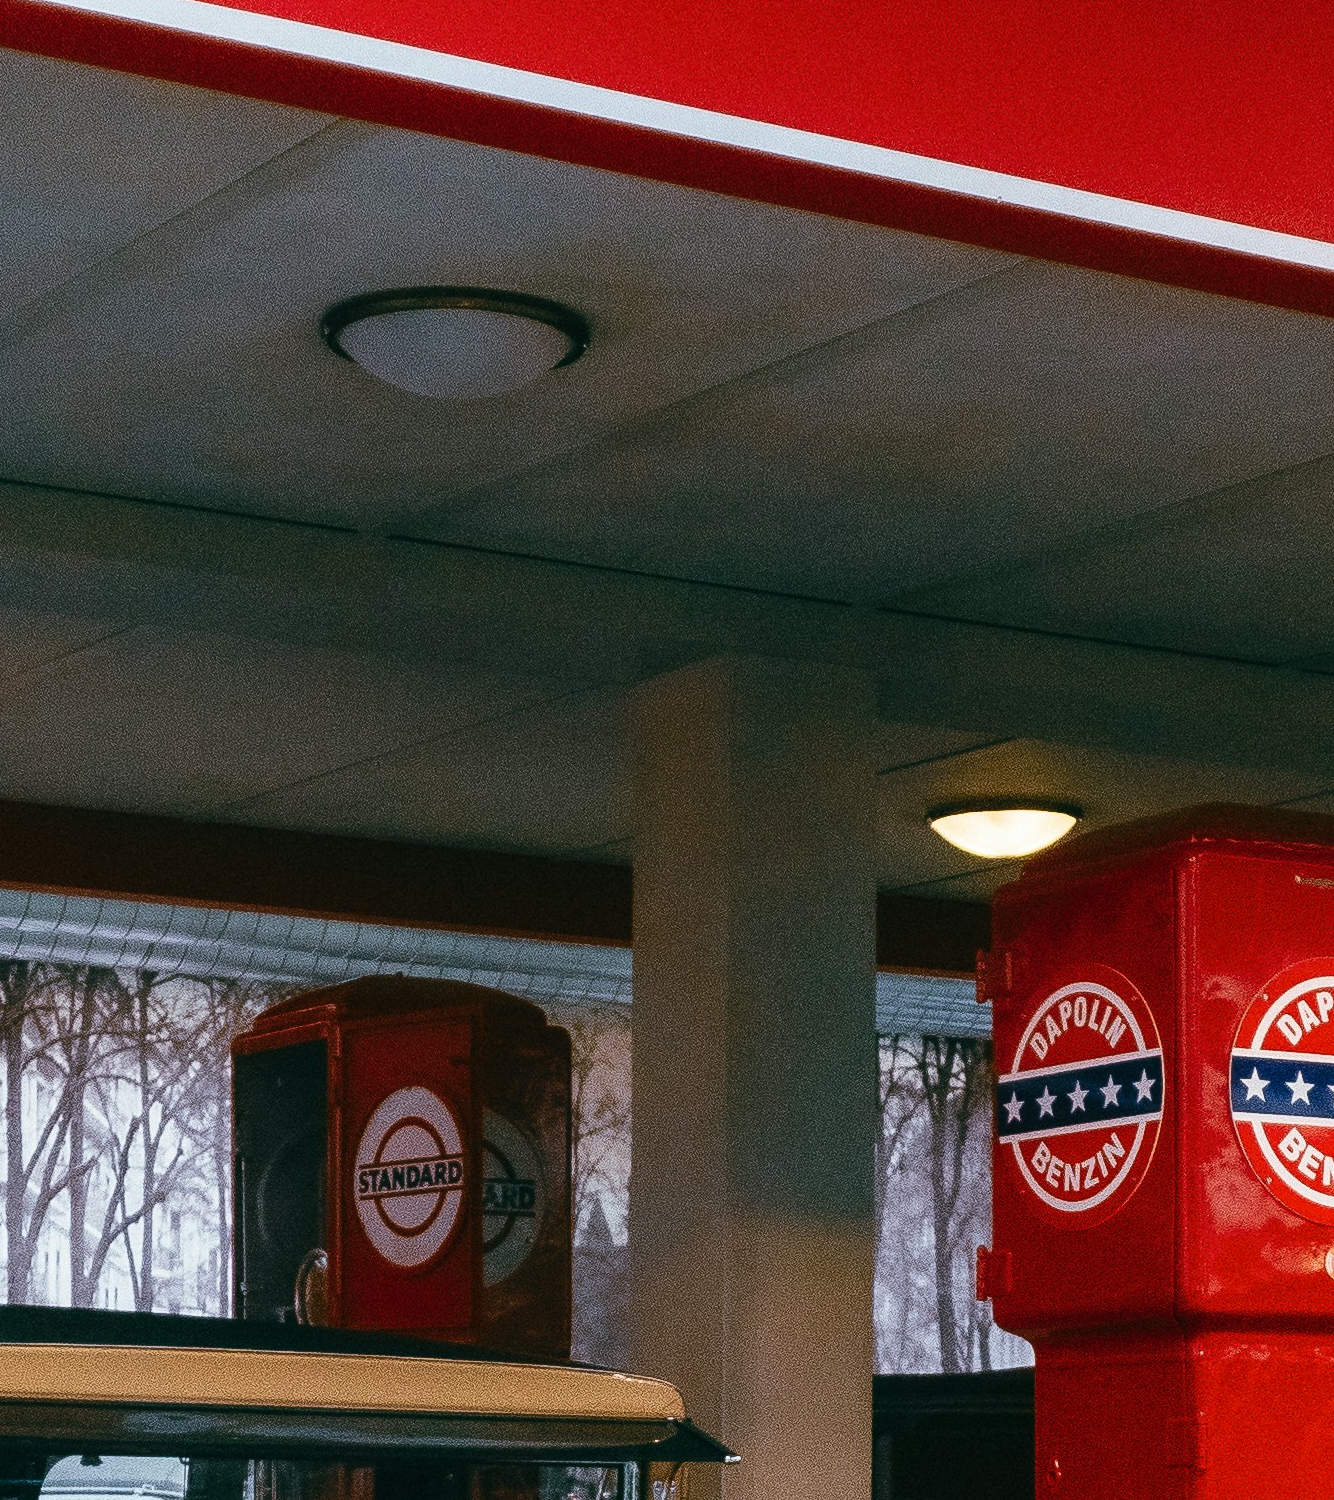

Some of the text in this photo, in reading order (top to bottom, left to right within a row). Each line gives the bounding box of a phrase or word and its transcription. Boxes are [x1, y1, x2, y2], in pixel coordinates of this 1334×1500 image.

[1030, 996, 1127, 1061] DAPOLIN
[358, 1160, 462, 1193] STANDARD
[1031, 1132, 1126, 1194] BENZIN
